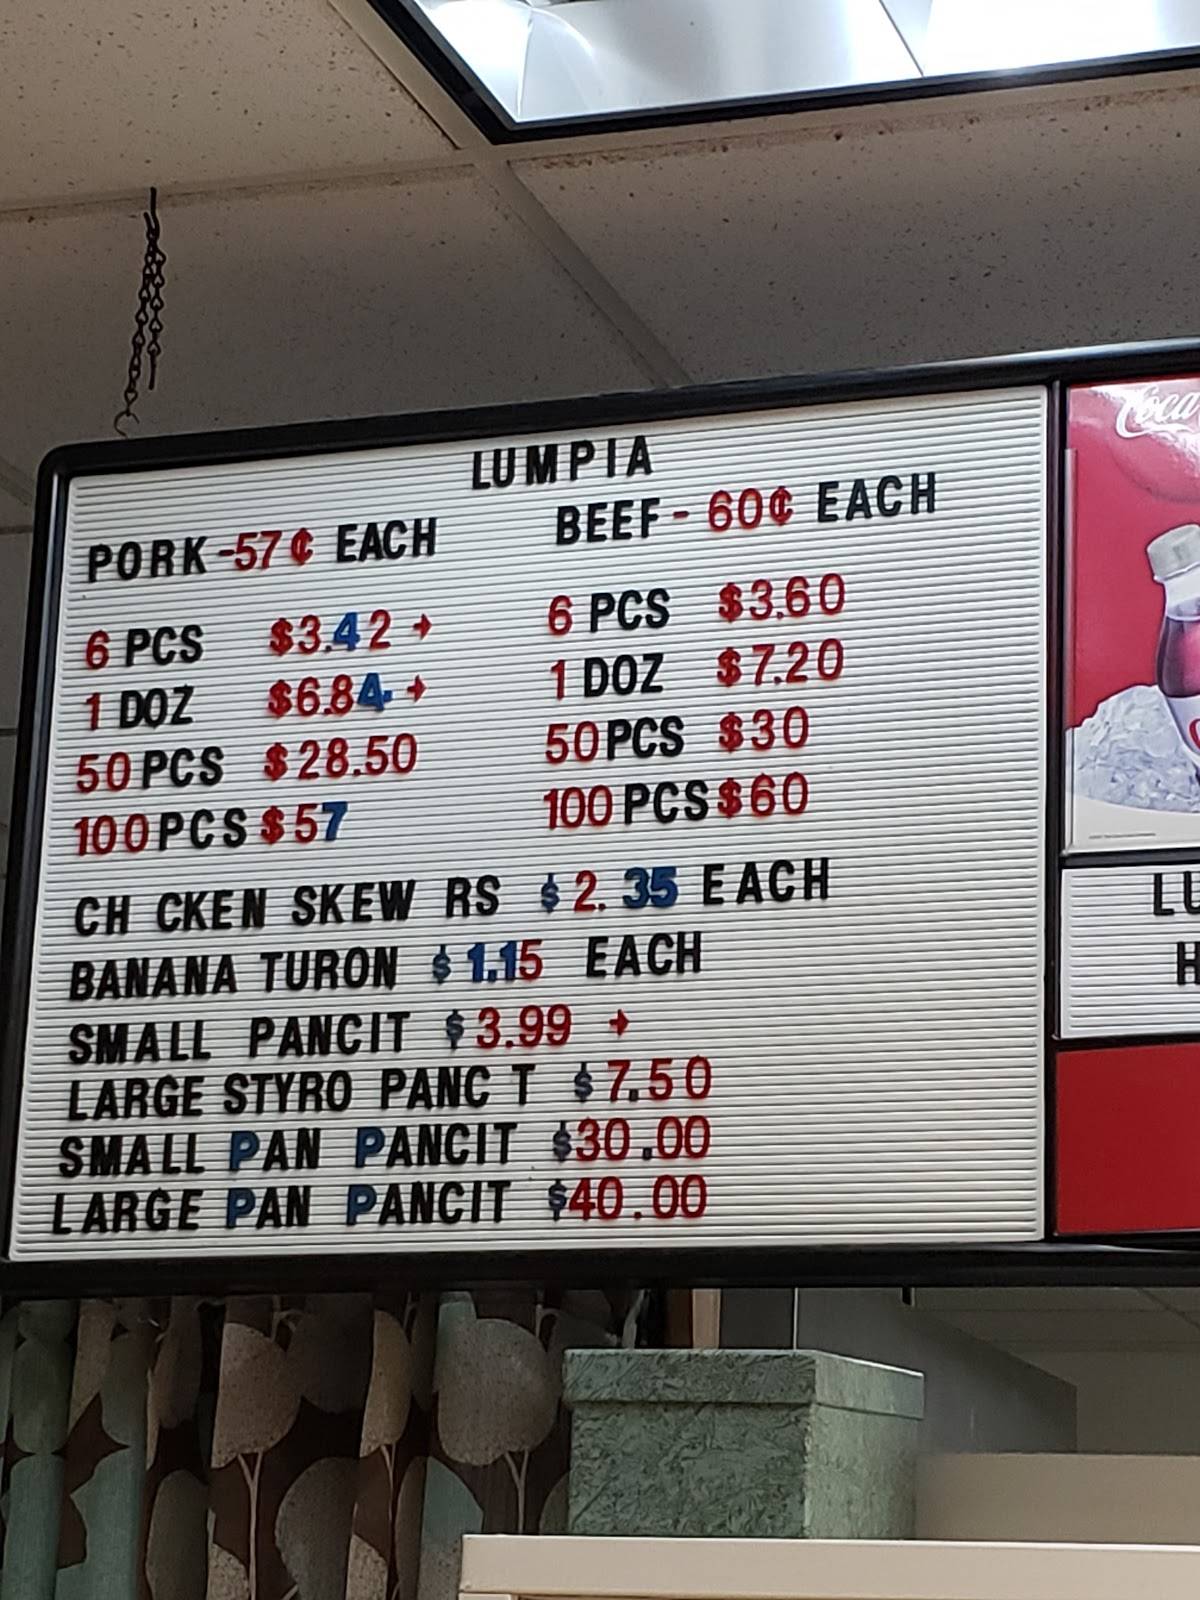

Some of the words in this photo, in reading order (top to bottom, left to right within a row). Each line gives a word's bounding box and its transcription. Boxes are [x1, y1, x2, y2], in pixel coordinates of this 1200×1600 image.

[469, 435, 654, 490] LUMPIA
[817, 471, 936, 523] EACH
[336, 517, 437, 564] EACH
[548, 595, 573, 636] 6
[589, 587, 670, 633] PCS
[718, 573, 845, 623] $3.60
[82, 630, 110, 670] 6
[123, 624, 204, 668] PCS
[269, 609, 391, 657] $3.42
[551, 659, 566, 700] 1
[583, 652, 664, 698] DOZ
[717, 638, 844, 688] $7.20
[83, 692, 102, 731] 1
[118, 684, 195, 729] DOZ
[719, 706, 809, 753] $30
[264, 733, 417, 782] $28.50
[717, 771, 809, 819] $60
[260, 801, 348, 845] $57
[702, 856, 833, 906] EACH
[66, 953, 239, 1002] BANANA
[259, 945, 399, 993] TURON
[585, 930, 703, 978] EACH
[65, 1019, 215, 1066] SMALL
[247, 1010, 412, 1059] PANCIT
[65, 1074, 208, 1122] LARGE
[220, 1069, 354, 1116] STYRO
[55, 1132, 208, 1179] SMALL
[226, 1127, 324, 1173] PAN
[352, 1121, 519, 1169] PANCIT
[550, 1115, 711, 1163] $30.00
[49, 1187, 208, 1236] LARGE
[223, 1184, 314, 1230] PAN
[344, 1179, 514, 1227] PANCIT
[545, 1174, 708, 1222] $40.00
